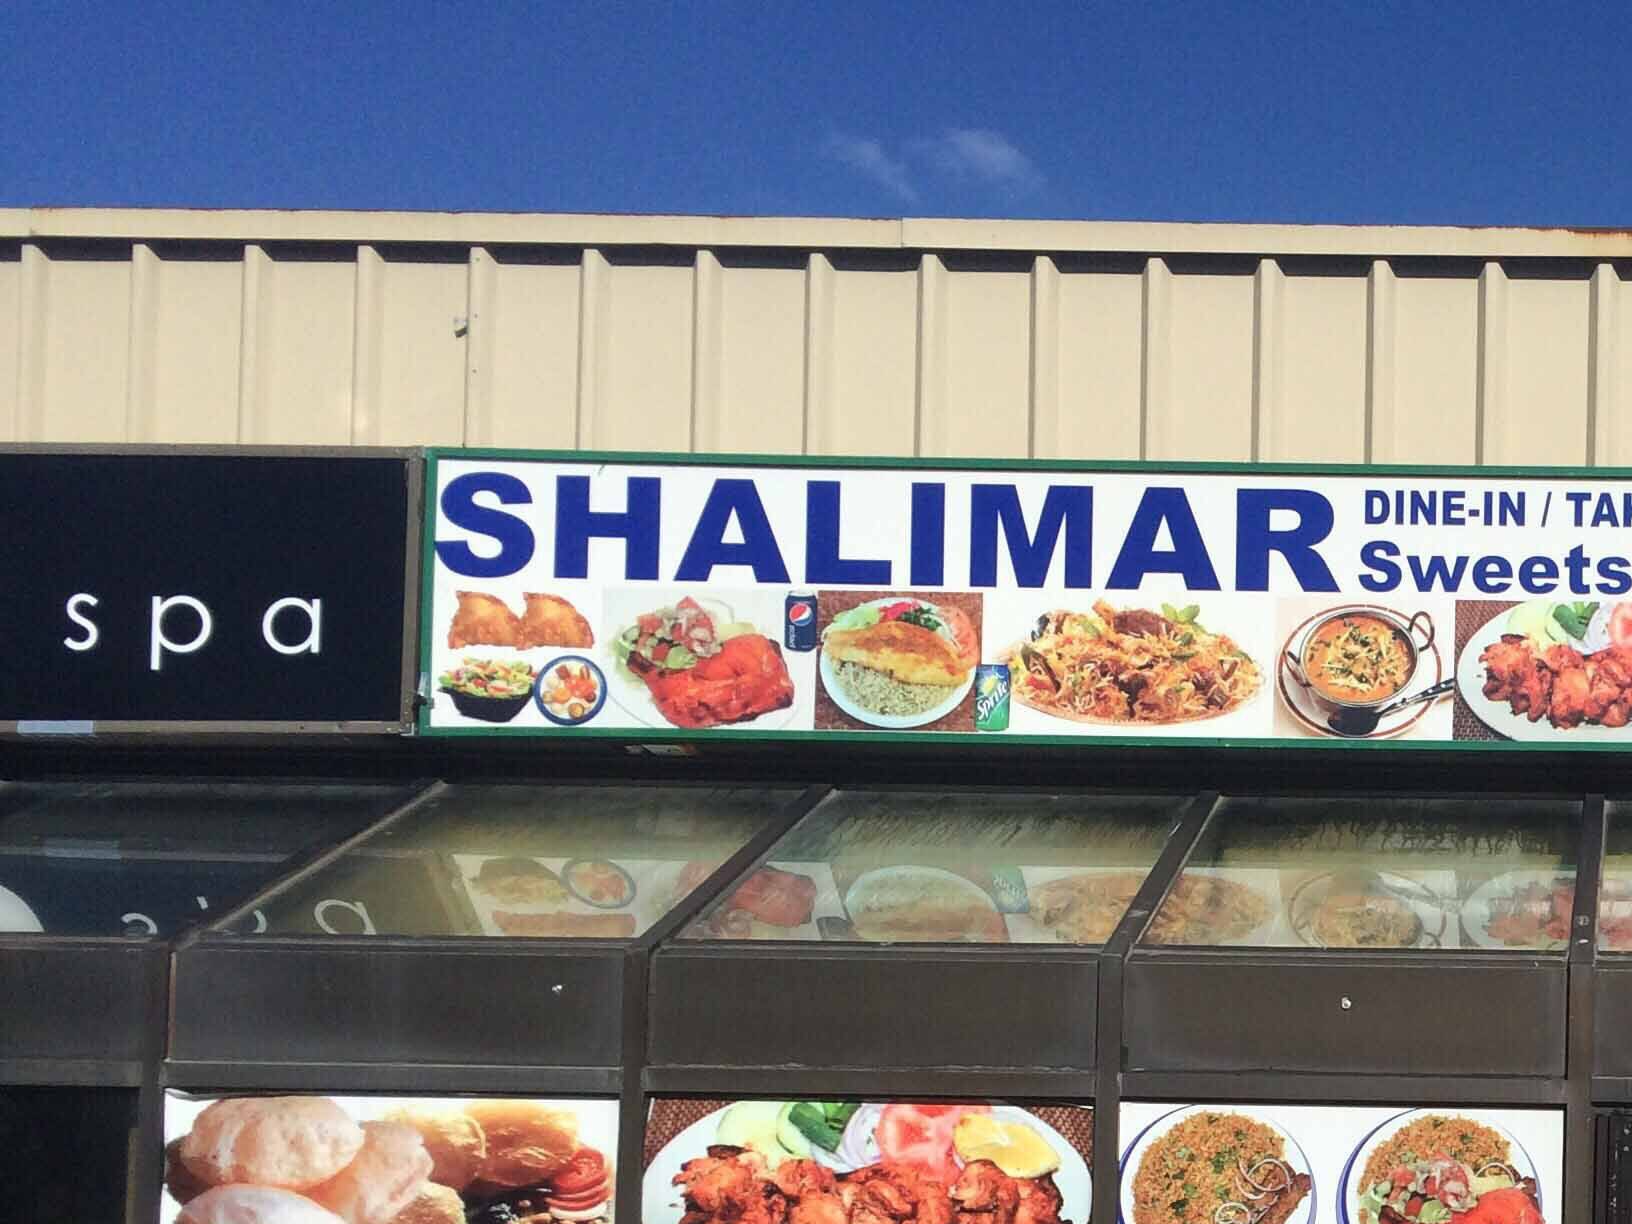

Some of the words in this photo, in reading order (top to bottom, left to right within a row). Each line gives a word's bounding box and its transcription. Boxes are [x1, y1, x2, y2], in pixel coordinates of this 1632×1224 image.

[433, 470, 1341, 592] SHALIMAR
[1364, 490, 1526, 526] DINE-IN
[1358, 540, 1632, 594] Sweets
[63, 592, 321, 671] spa
